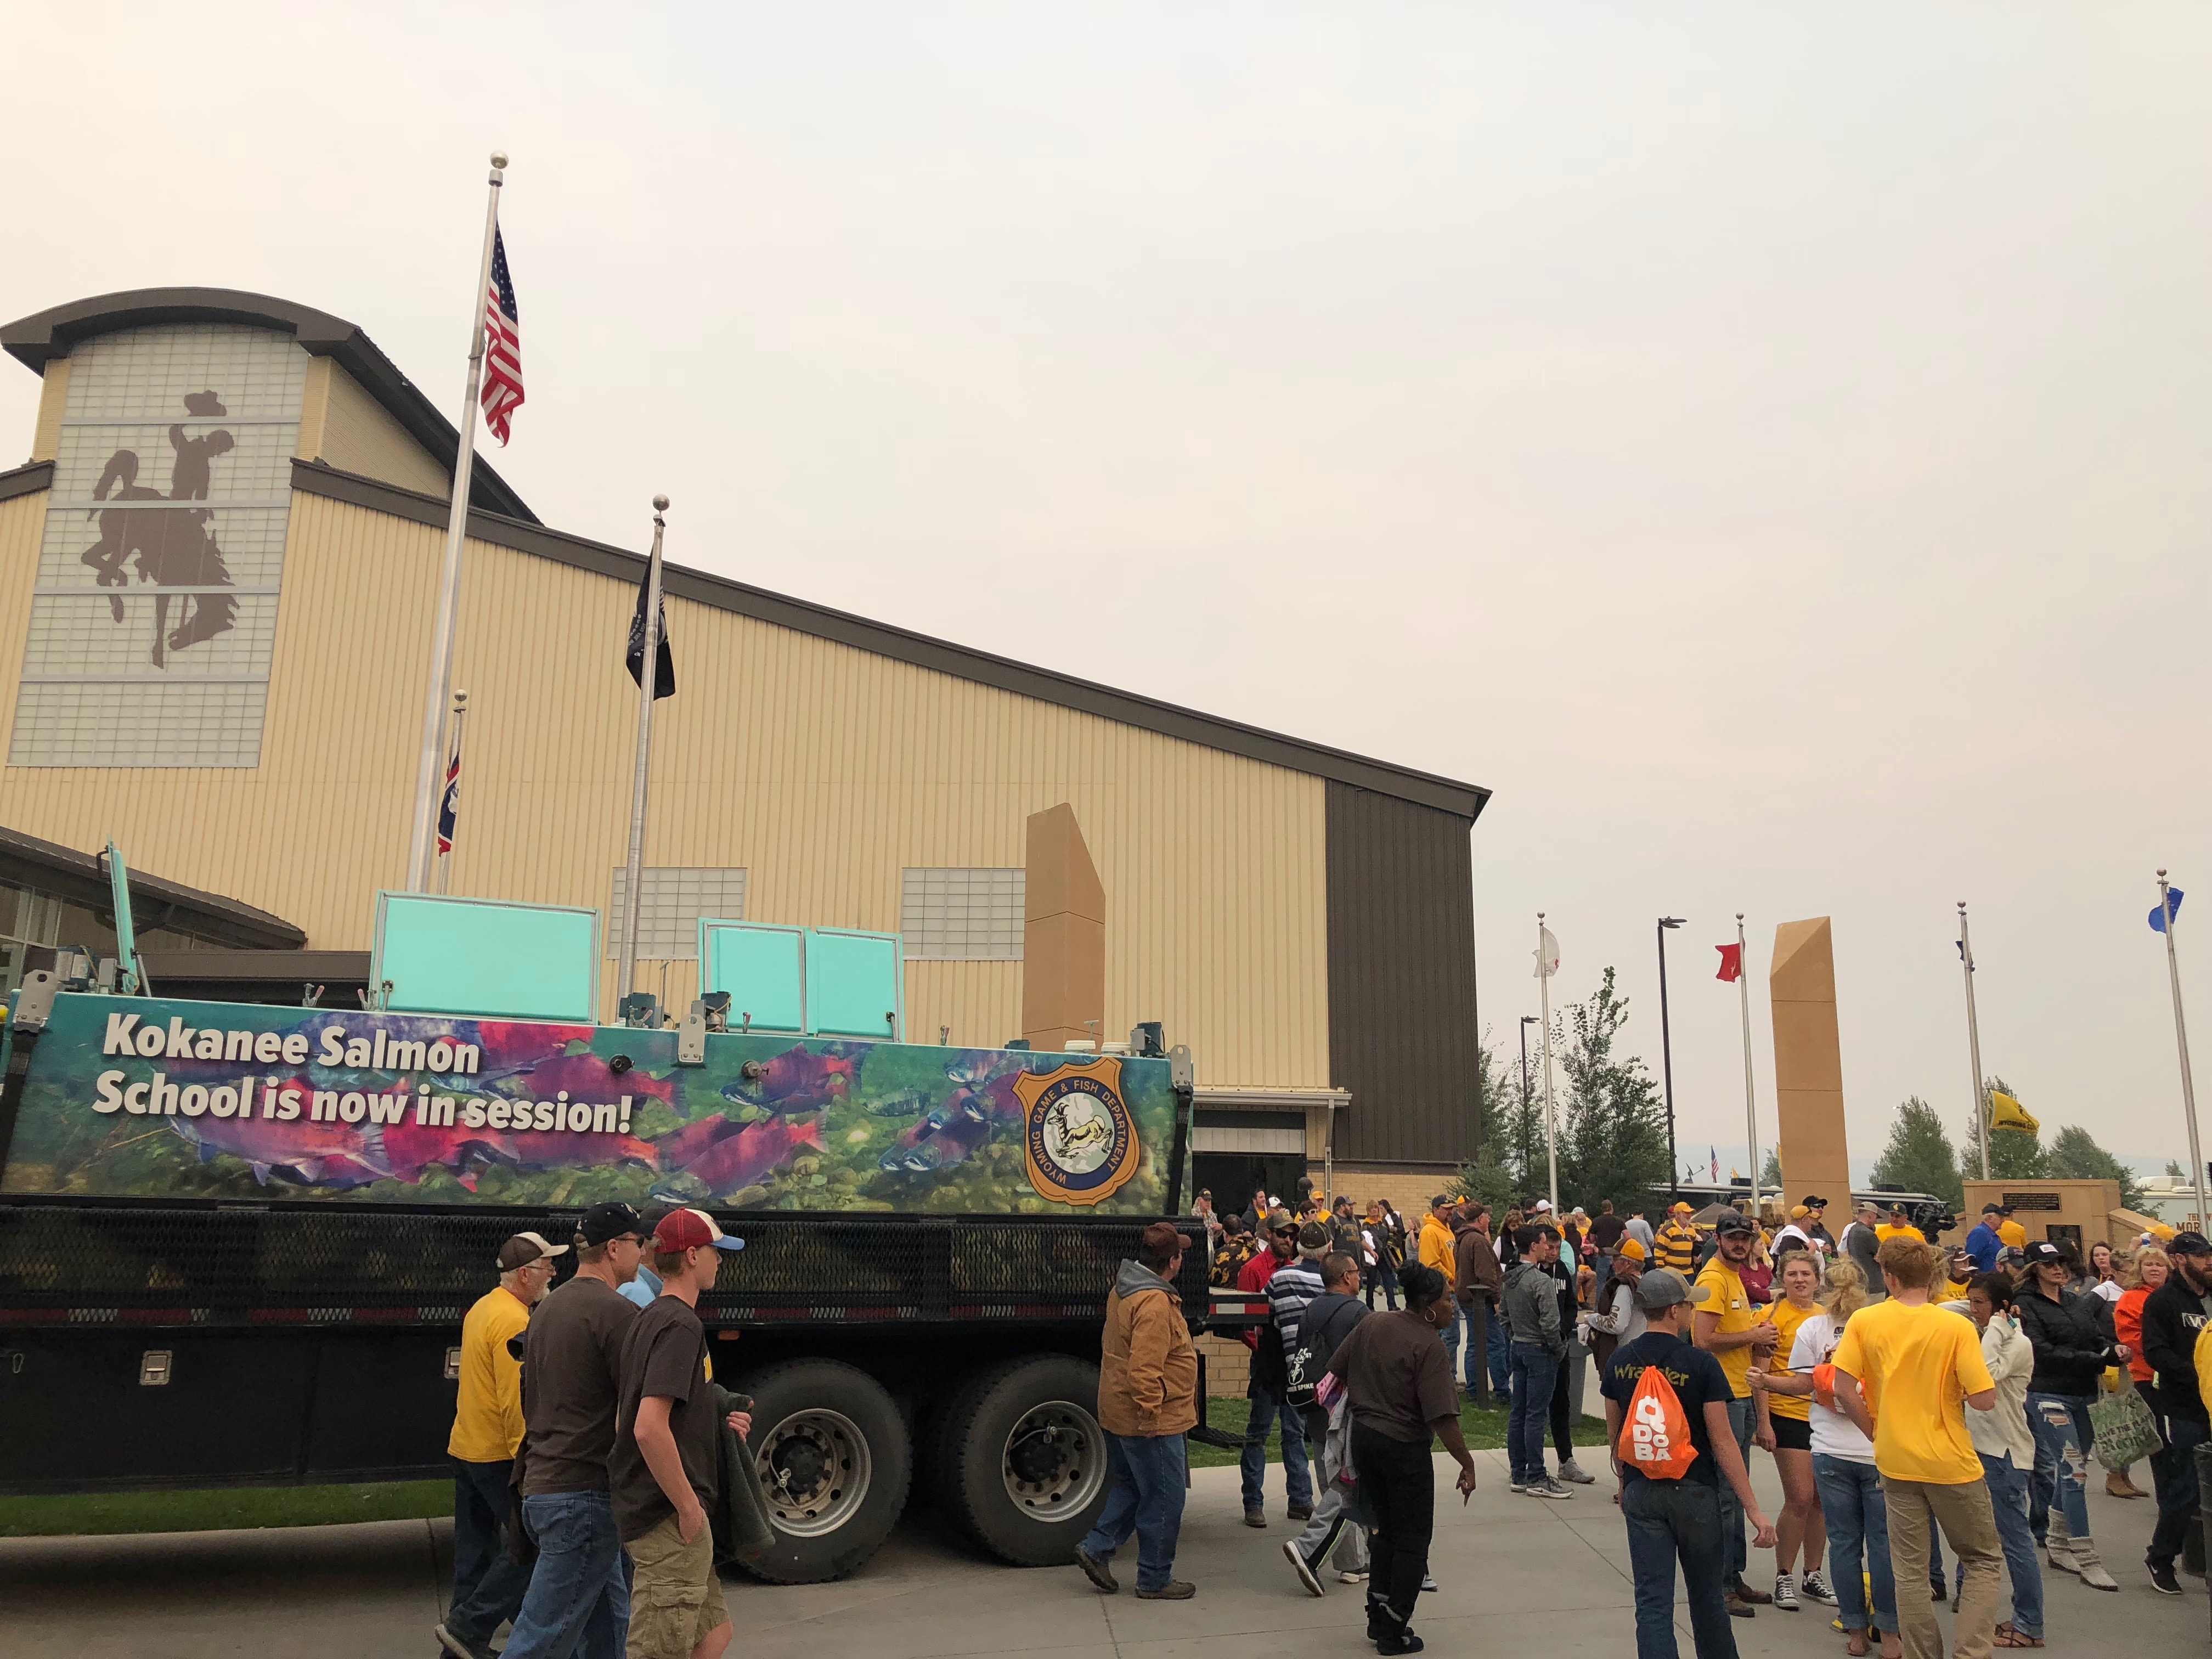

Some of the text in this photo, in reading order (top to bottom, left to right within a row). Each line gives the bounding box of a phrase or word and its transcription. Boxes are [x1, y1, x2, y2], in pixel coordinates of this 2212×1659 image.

[103, 1013, 480, 1074] Kokanee Salmon
[92, 1070, 633, 1133] School is now in session!
[1031, 1079, 1126, 1184] WYOMING GAME & FISH DEPARTMENT
[1614, 1363, 1690, 1387] Wraler
